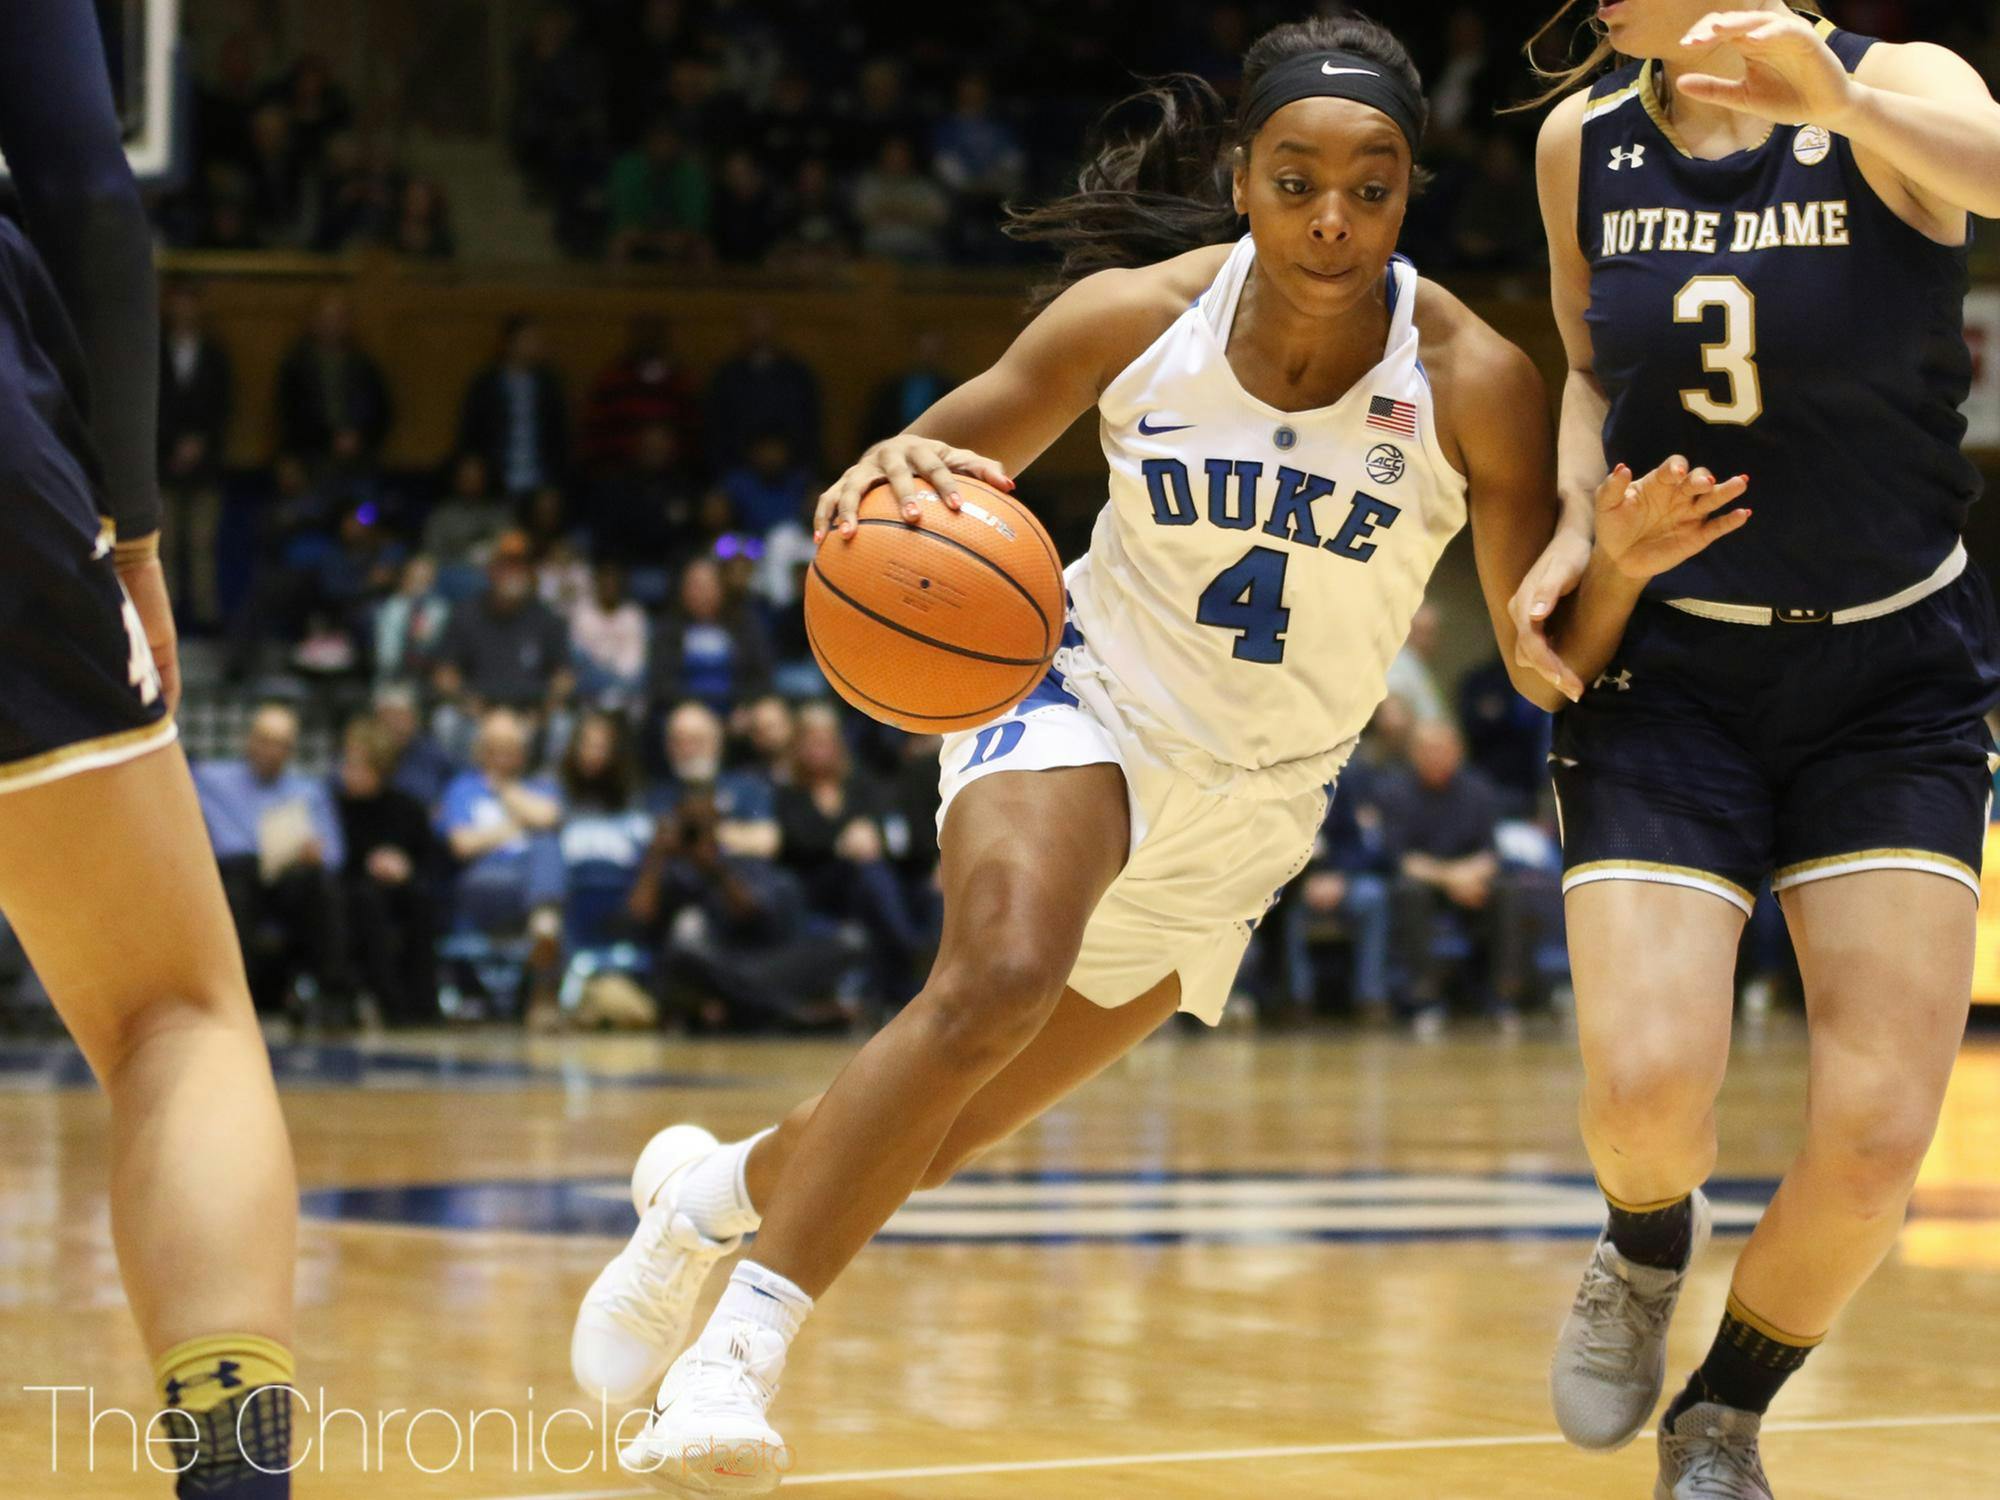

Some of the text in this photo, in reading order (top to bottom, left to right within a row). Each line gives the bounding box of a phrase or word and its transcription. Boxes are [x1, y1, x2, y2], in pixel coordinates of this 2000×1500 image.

[1601, 200, 1850, 257] NOTRE DAME
[1673, 275, 1763, 426] 3
[1142, 458, 1401, 563] DUKE
[1196, 545, 1290, 664] 4
